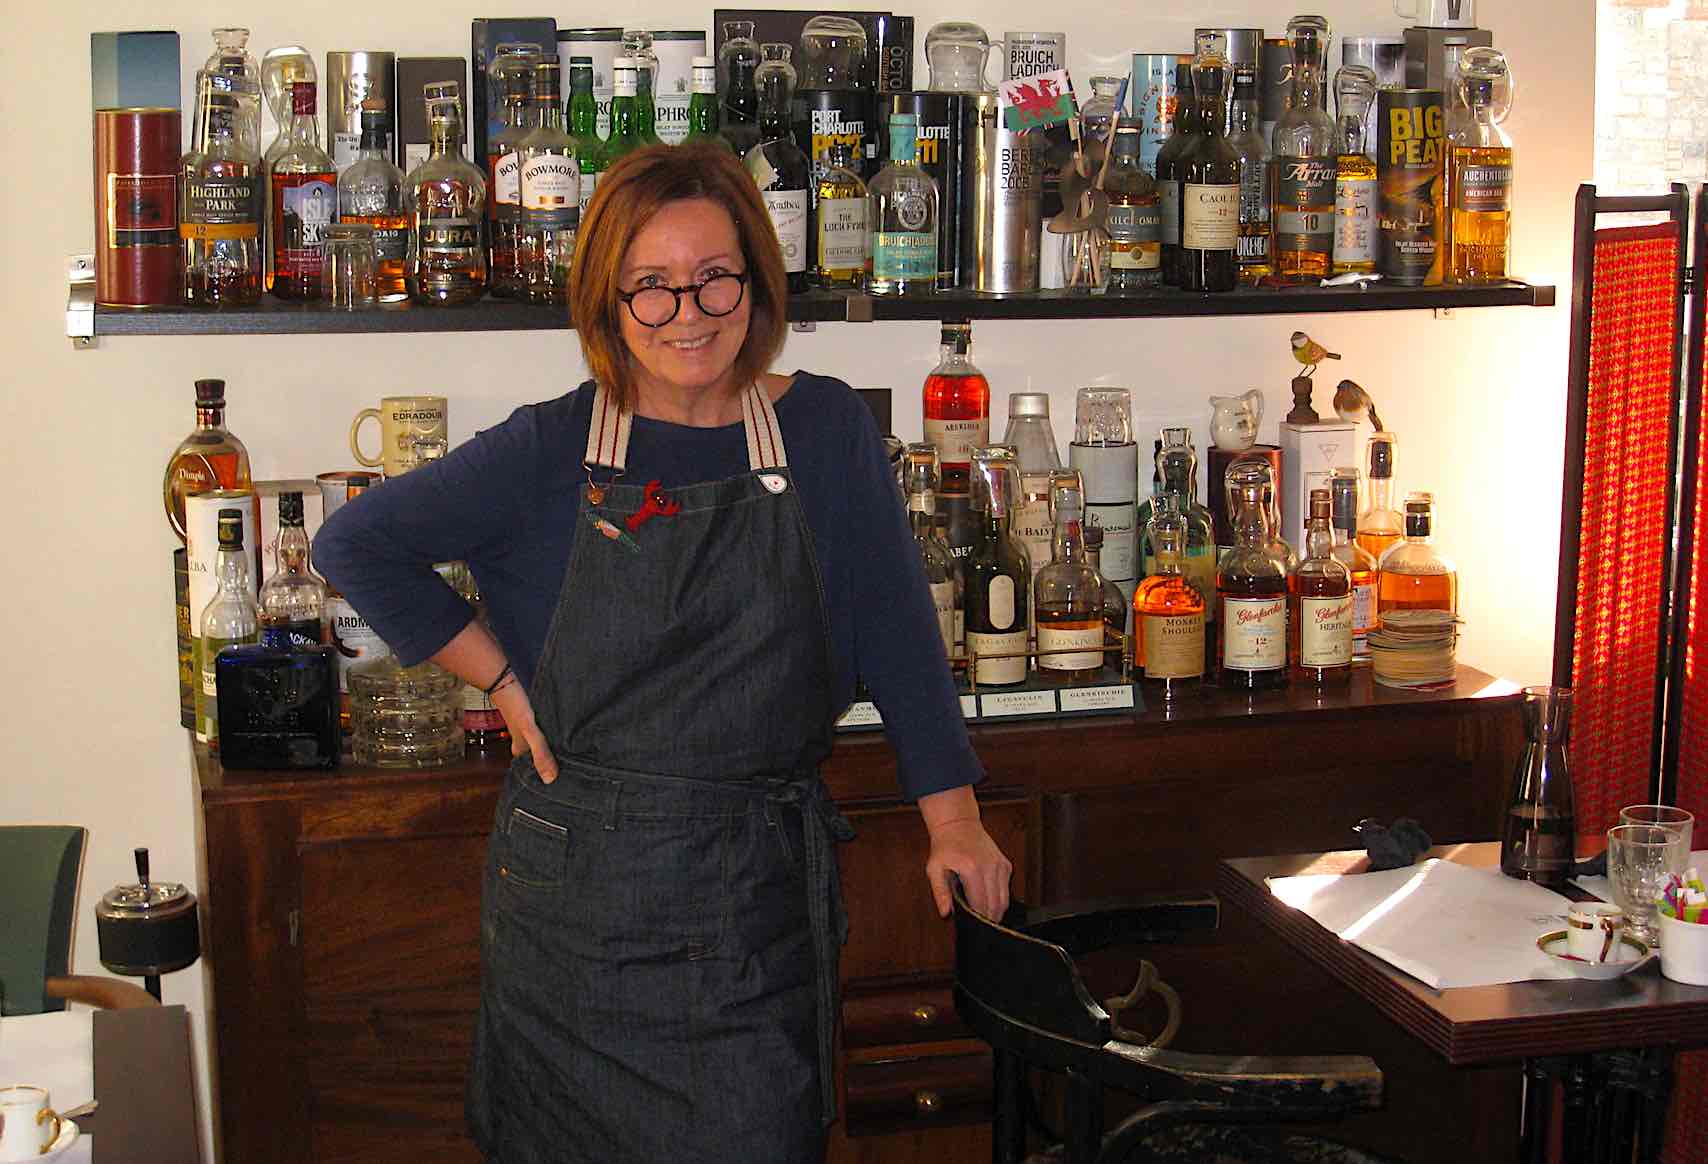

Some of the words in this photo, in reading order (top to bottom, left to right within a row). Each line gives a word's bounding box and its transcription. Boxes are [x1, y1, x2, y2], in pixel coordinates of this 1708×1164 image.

[1010, 50, 1054, 64] BRUICH
[811, 109, 841, 122] PORT
[1389, 106, 1442, 140] BIG
[525, 164, 578, 181] BOWMORE
[1282, 162, 1337, 181] Arran
[190, 186, 251, 199] HIGHLAND
[205, 200, 237, 211] PARK
[1303, 214, 1319, 232] 10
[424, 230, 473, 243] JURA
[392, 411, 442, 421] EDRADOUR
